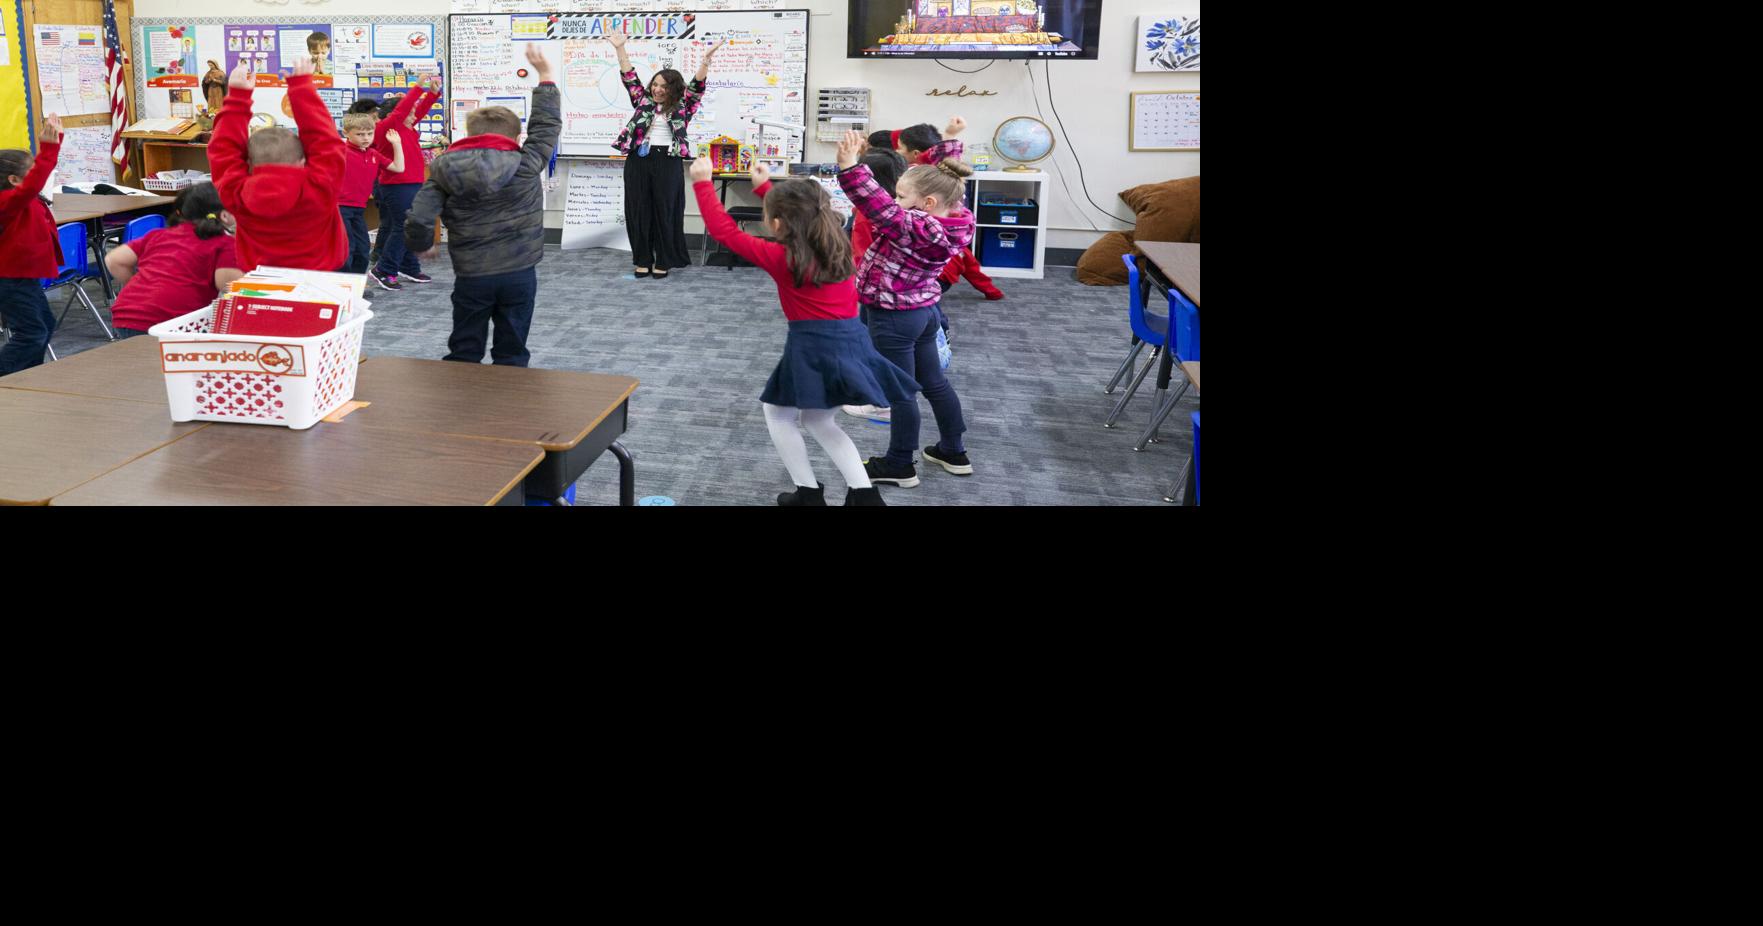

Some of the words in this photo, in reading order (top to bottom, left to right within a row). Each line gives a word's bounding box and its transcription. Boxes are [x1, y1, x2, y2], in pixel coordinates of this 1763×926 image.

[590, 17, 678, 35] APRENDER
[925, 85, 998, 97] relax
[165, 351, 256, 363] anaranjado
